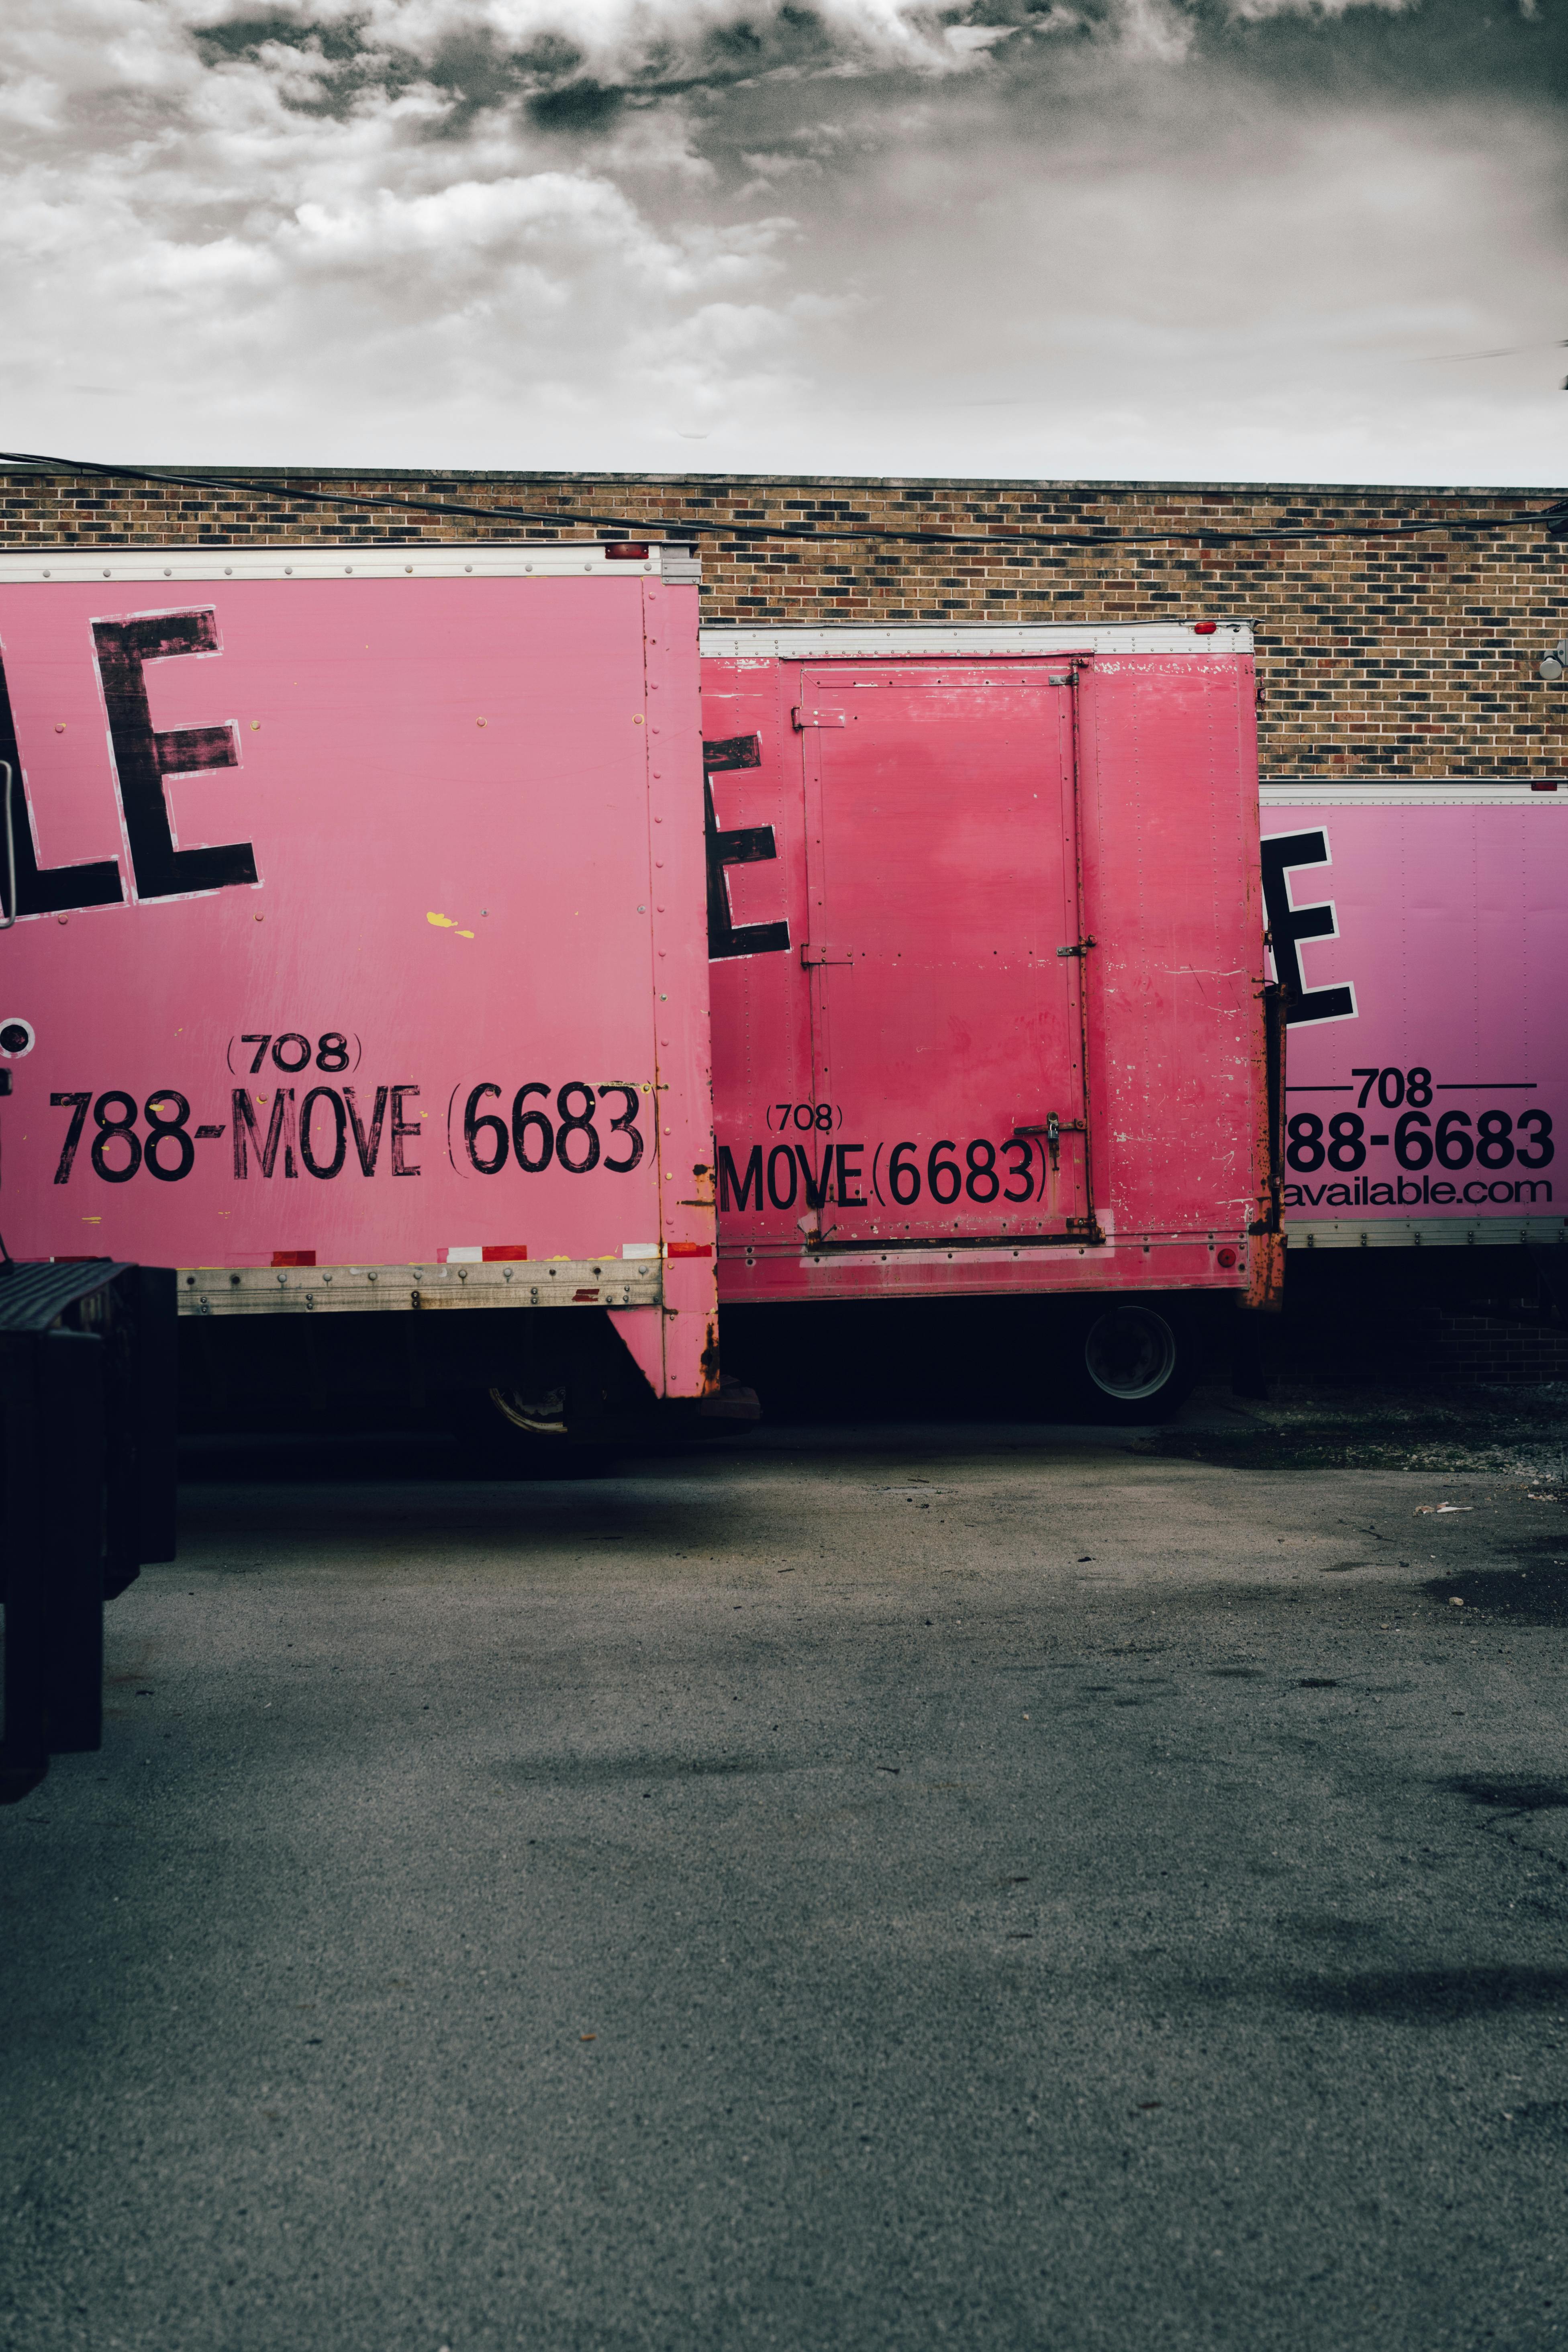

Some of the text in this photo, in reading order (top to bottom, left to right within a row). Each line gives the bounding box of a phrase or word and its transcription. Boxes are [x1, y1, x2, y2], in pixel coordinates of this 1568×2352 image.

[703, 731, 792, 963] E
[1260, 825, 1359, 1029] E
[227, 1032, 361, 1075] (708)
[1352, 1067, 1433, 1109] 708
[50, 1080, 658, 1184] 788-MOVE (6683)
[766, 1103, 843, 1131] (708)
[1285, 1109, 1555, 1173] 88-6683
[1284, 1175, 1553, 1207] available.com
